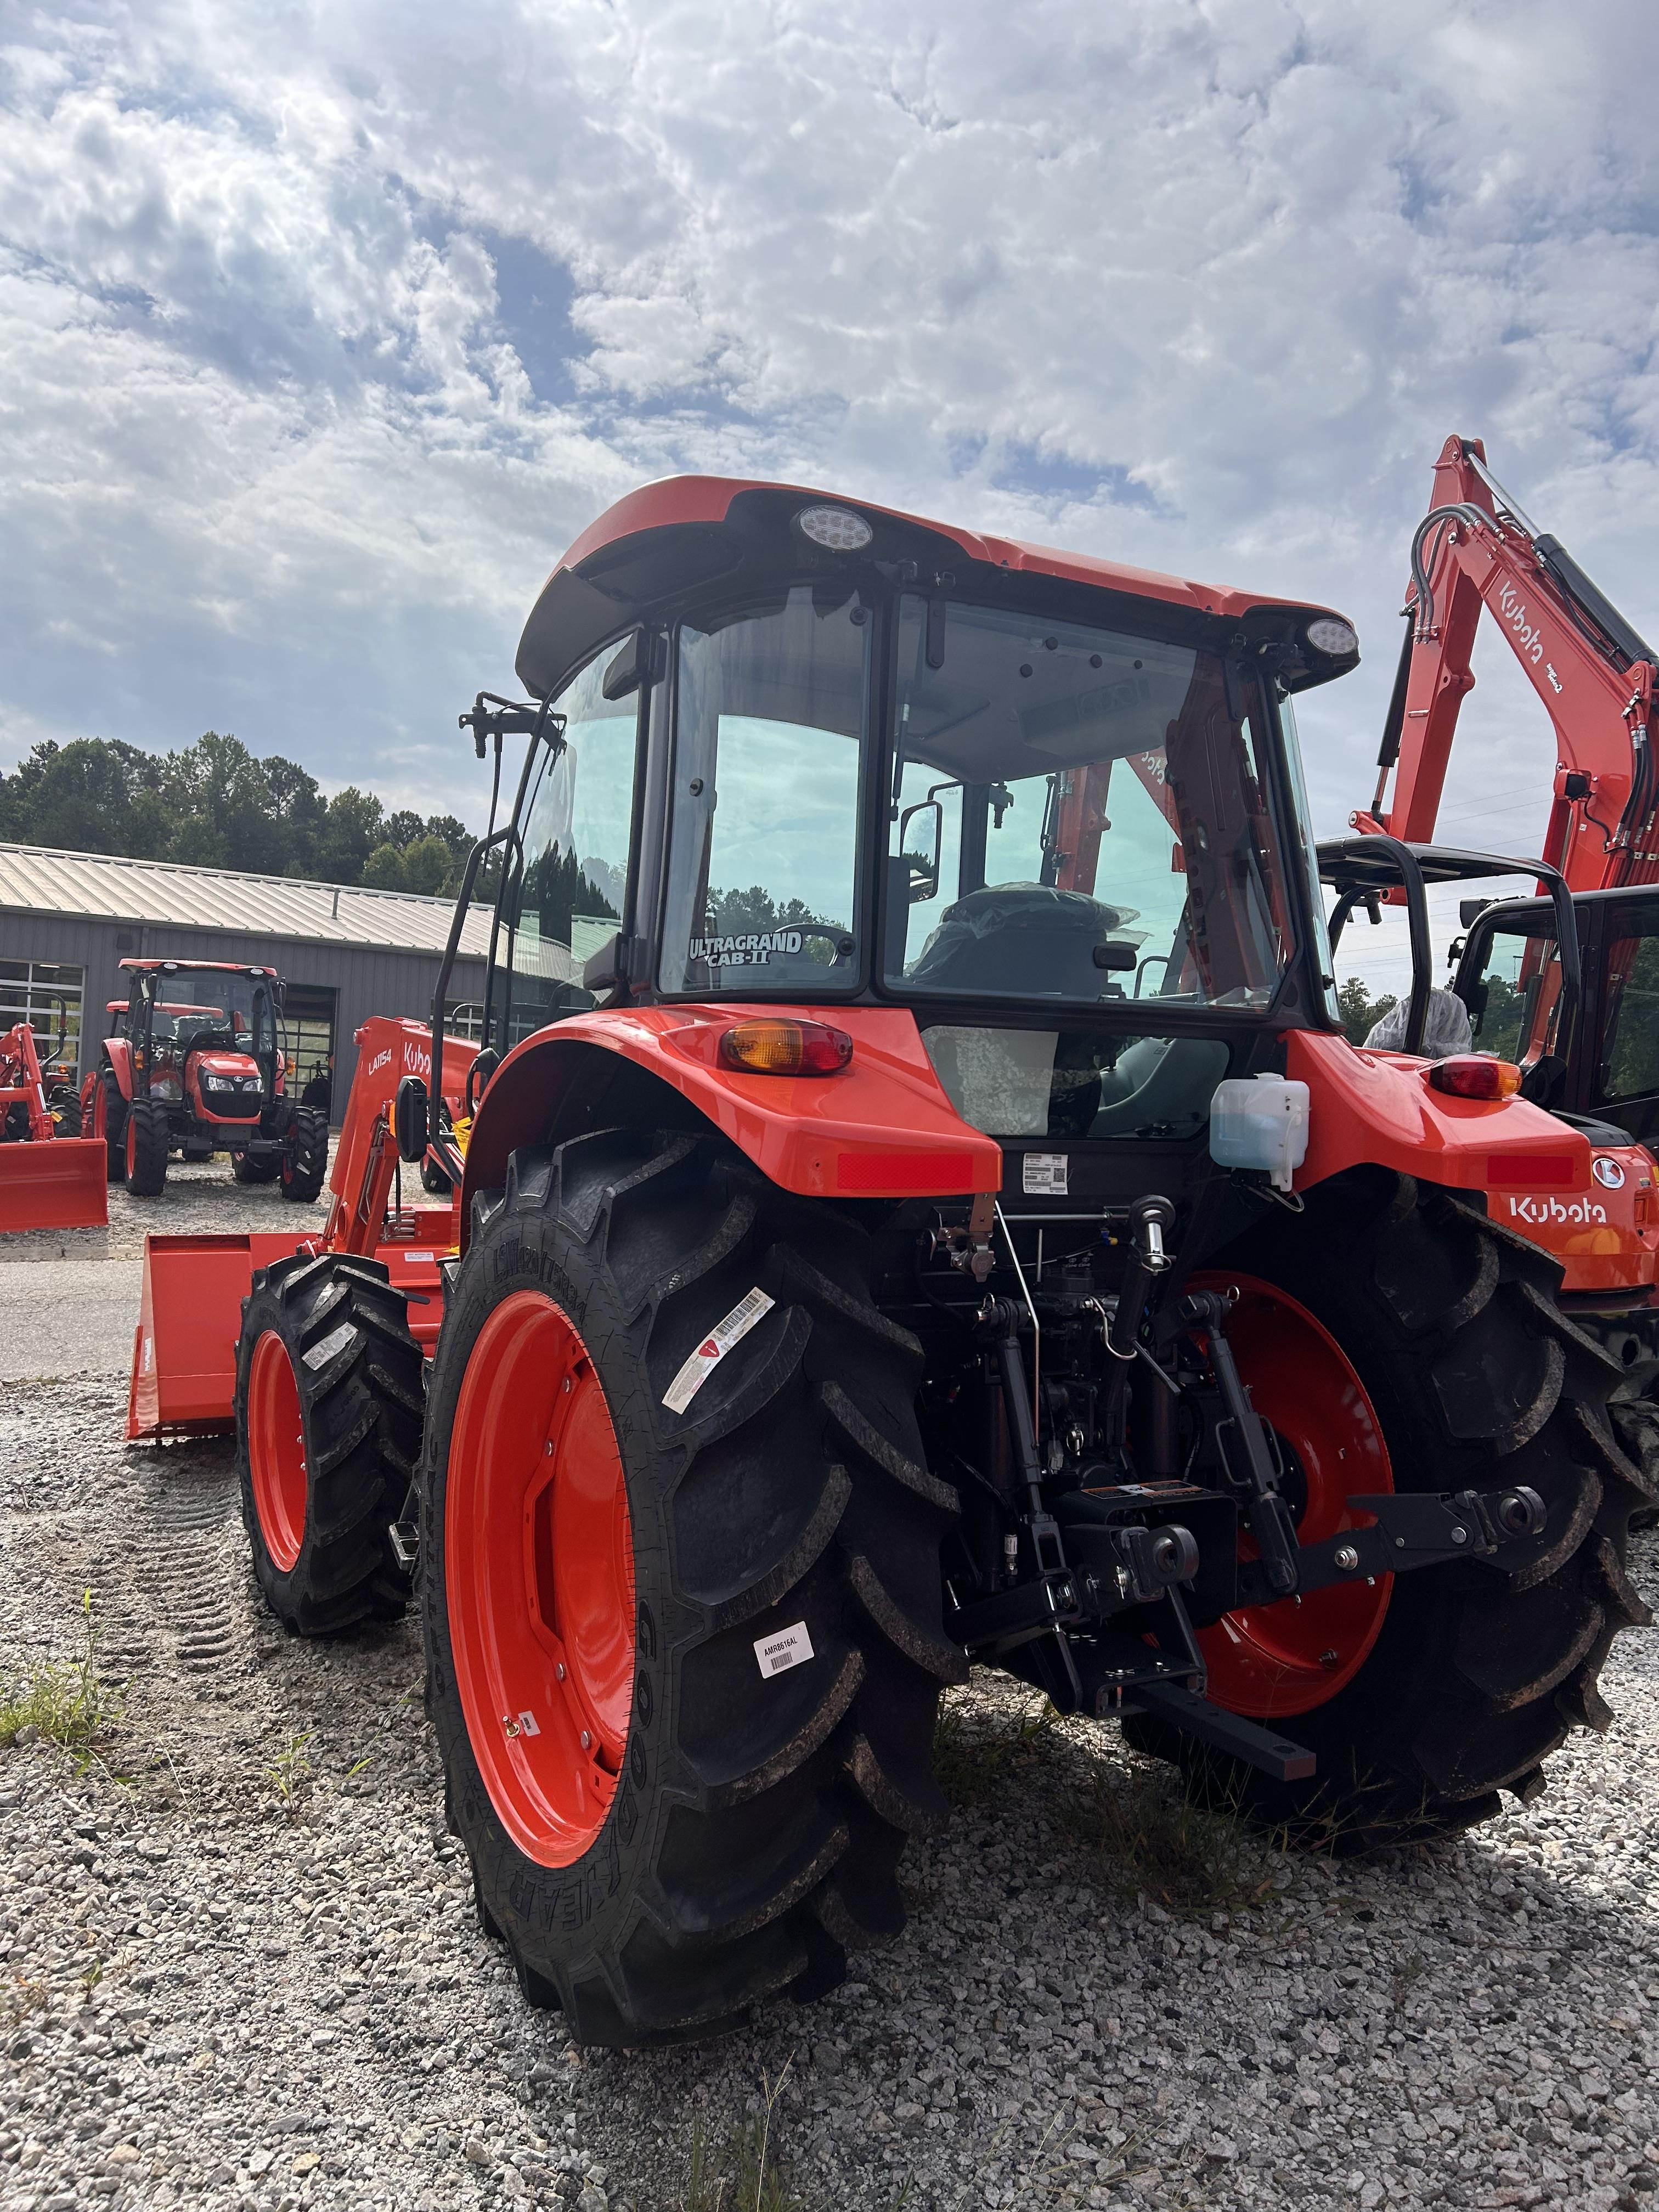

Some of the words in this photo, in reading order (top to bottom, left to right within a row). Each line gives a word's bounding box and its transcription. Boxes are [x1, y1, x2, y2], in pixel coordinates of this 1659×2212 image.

[1499, 580, 1543, 664] Kubota
[690, 932, 803, 959] ULTRAGRAND
[707, 950, 770, 968] CAB-II
[368, 1048, 392, 1076] LA1154
[404, 1041, 431, 1075] Kubo
[1510, 1197, 1606, 1223] Kubota
[764, 1636, 798, 1657] AMR8616AL
